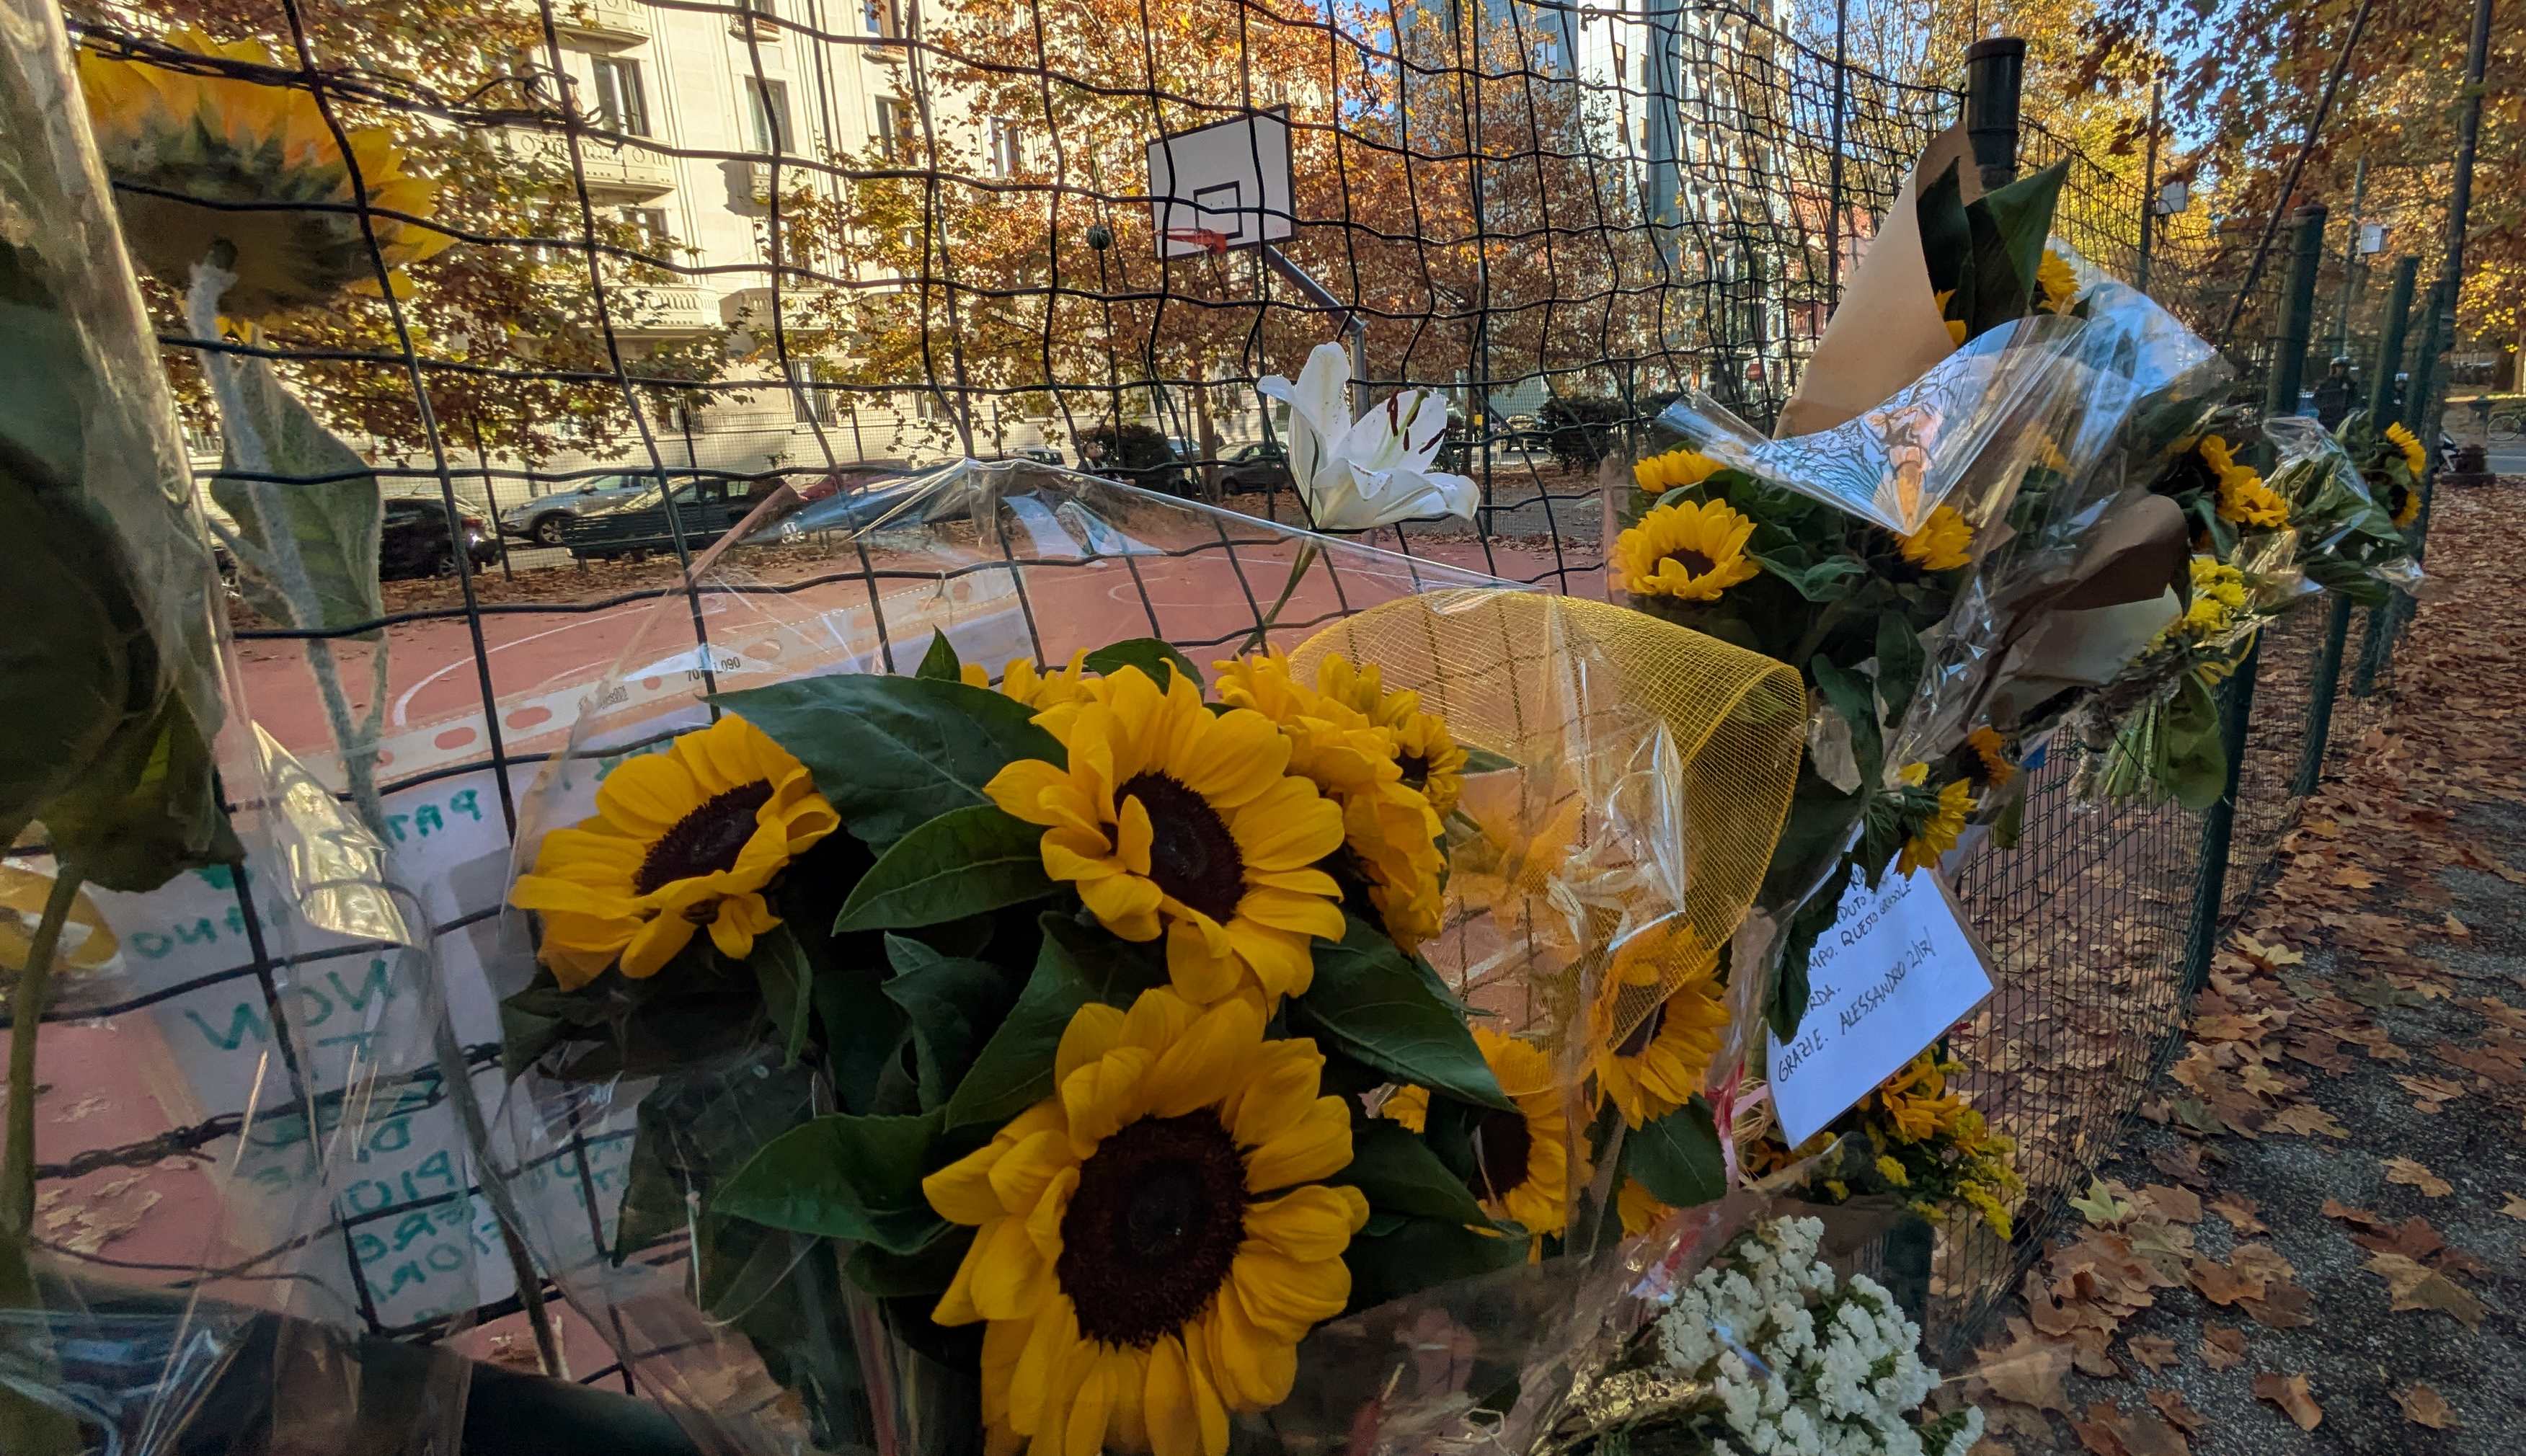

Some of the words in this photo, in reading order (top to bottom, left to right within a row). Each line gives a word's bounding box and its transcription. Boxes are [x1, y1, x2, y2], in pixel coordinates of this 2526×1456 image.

[1833, 895, 1866, 925] DUTO
[1808, 945, 1838, 971] MPO.
[1840, 912, 1879, 946] QUESTO
[1778, 1028, 1829, 1083] GRAZIE.
[1839, 961, 1906, 1036] ALESSANDRO
[1804, 984, 1841, 1015] RDA.
